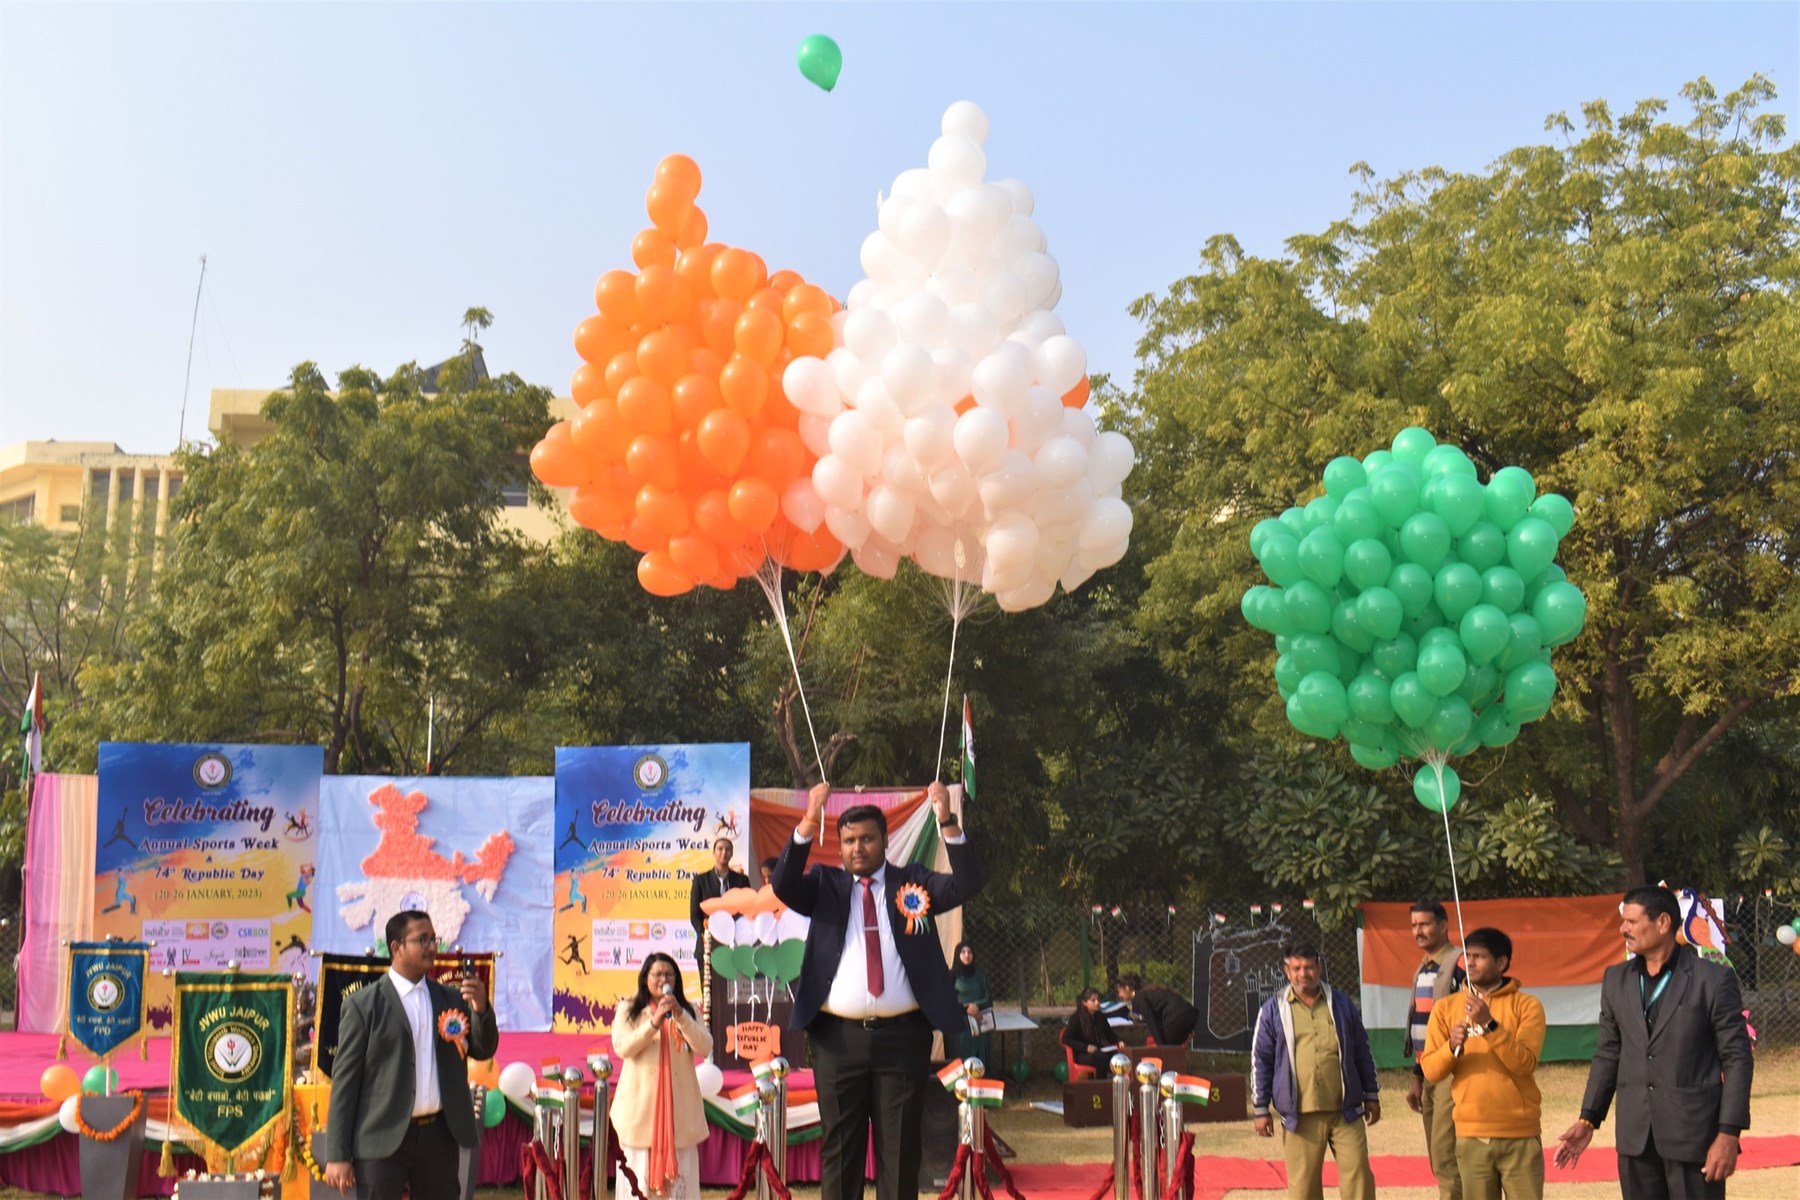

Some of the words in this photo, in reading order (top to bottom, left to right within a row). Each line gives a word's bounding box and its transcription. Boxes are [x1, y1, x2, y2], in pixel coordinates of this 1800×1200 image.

[144, 798, 275, 832] Celebrating
[592, 799, 706, 832] Celebrating
[140, 837, 188, 854] Annual
[192, 838, 235, 851] Sports
[241, 837, 279, 850] Week
[589, 839, 630, 854] Annual
[634, 839, 671, 852] Sports
[676, 839, 710, 850] Week
[181, 868, 235, 882] Republic
[240, 868, 264, 881] Day
[625, 868, 671, 882] Republic
[186, 888, 235, 900] JANUARY,
[237, 888, 263, 900] 2023)
[629, 889, 671, 900] JANUARY,
[199, 1006, 226, 1032] JVWU
[230, 1006, 270, 1031] JAIPUR
[742, 1025, 765, 1033] HAPPY
[743, 1044, 758, 1052] DAY
[1211, 1087, 1220, 1102] 3
[1092, 1094, 1102, 1110] 2
[217, 1104, 243, 1118] FPS
